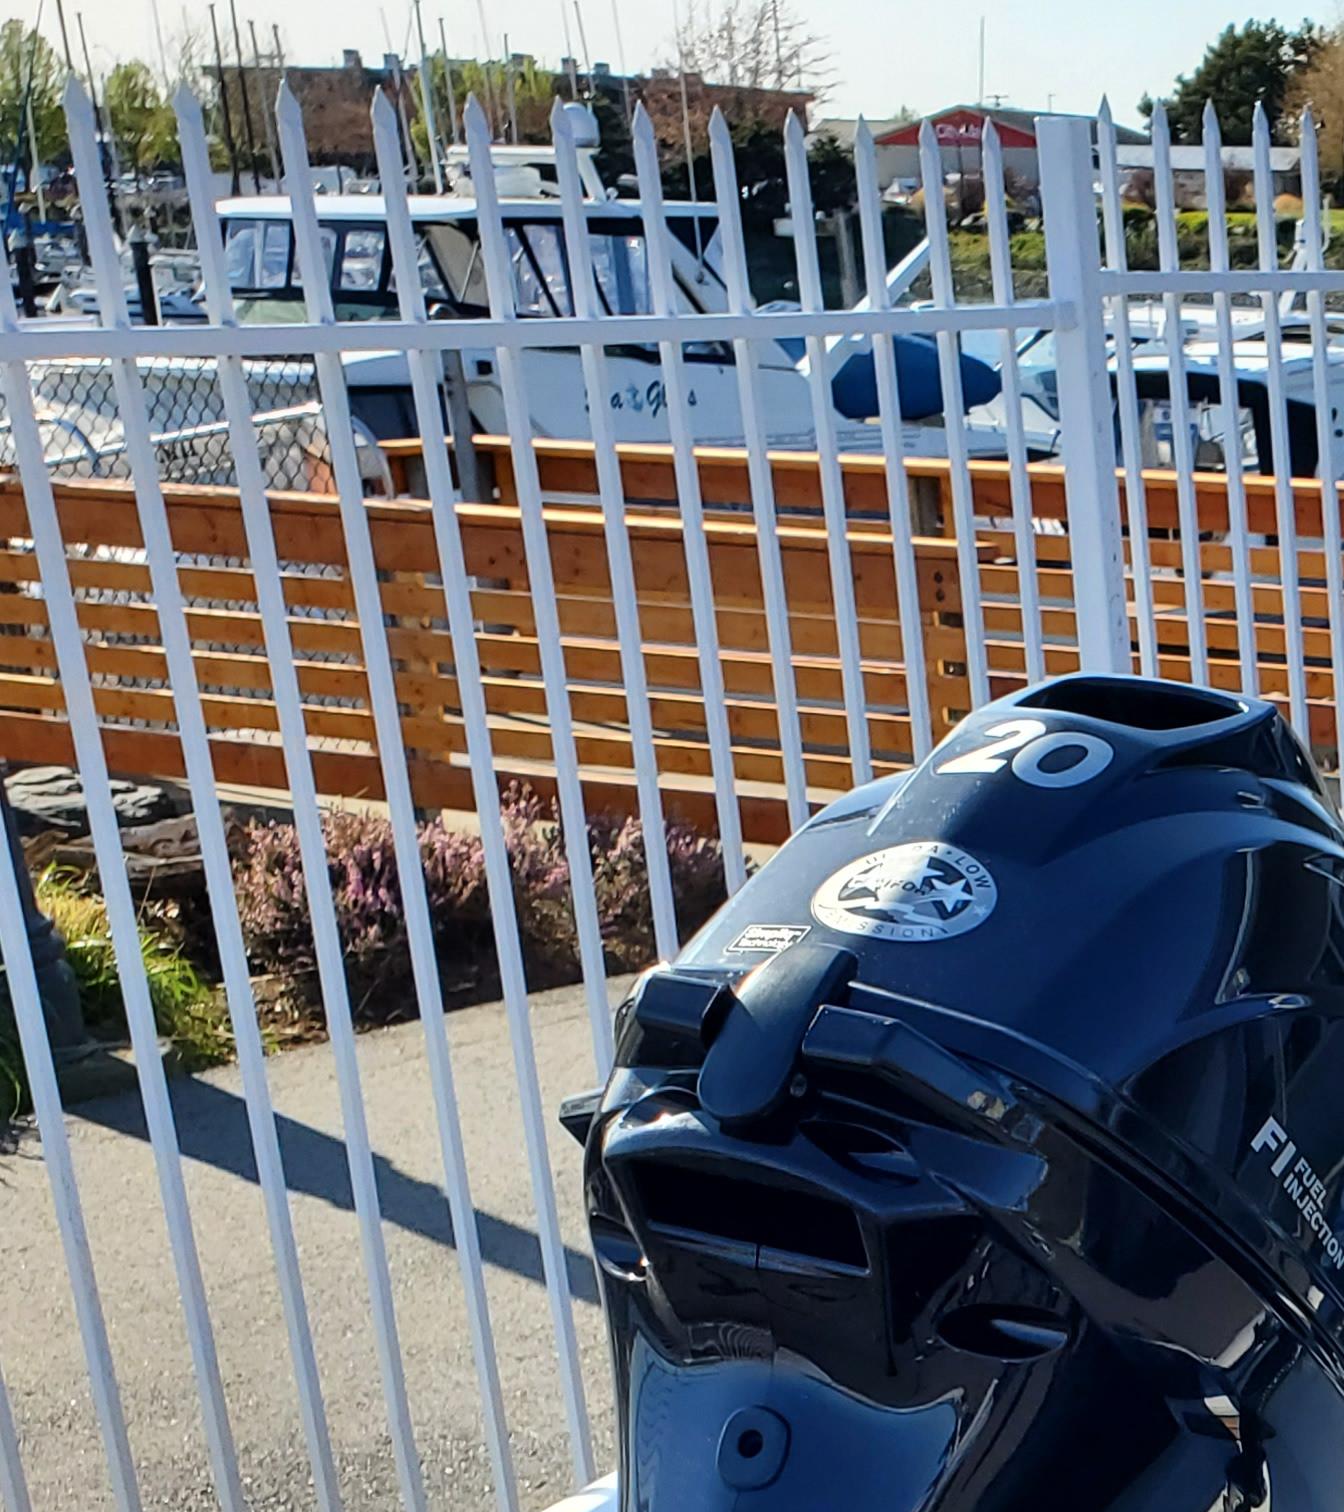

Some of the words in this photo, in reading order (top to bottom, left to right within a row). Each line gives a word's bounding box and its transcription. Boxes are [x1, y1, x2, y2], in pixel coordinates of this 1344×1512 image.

[935, 718, 1114, 790] 20
[955, 854, 992, 889] LOW
[1250, 1115, 1297, 1178] FI
[1293, 1156, 1329, 1209] FUEL
